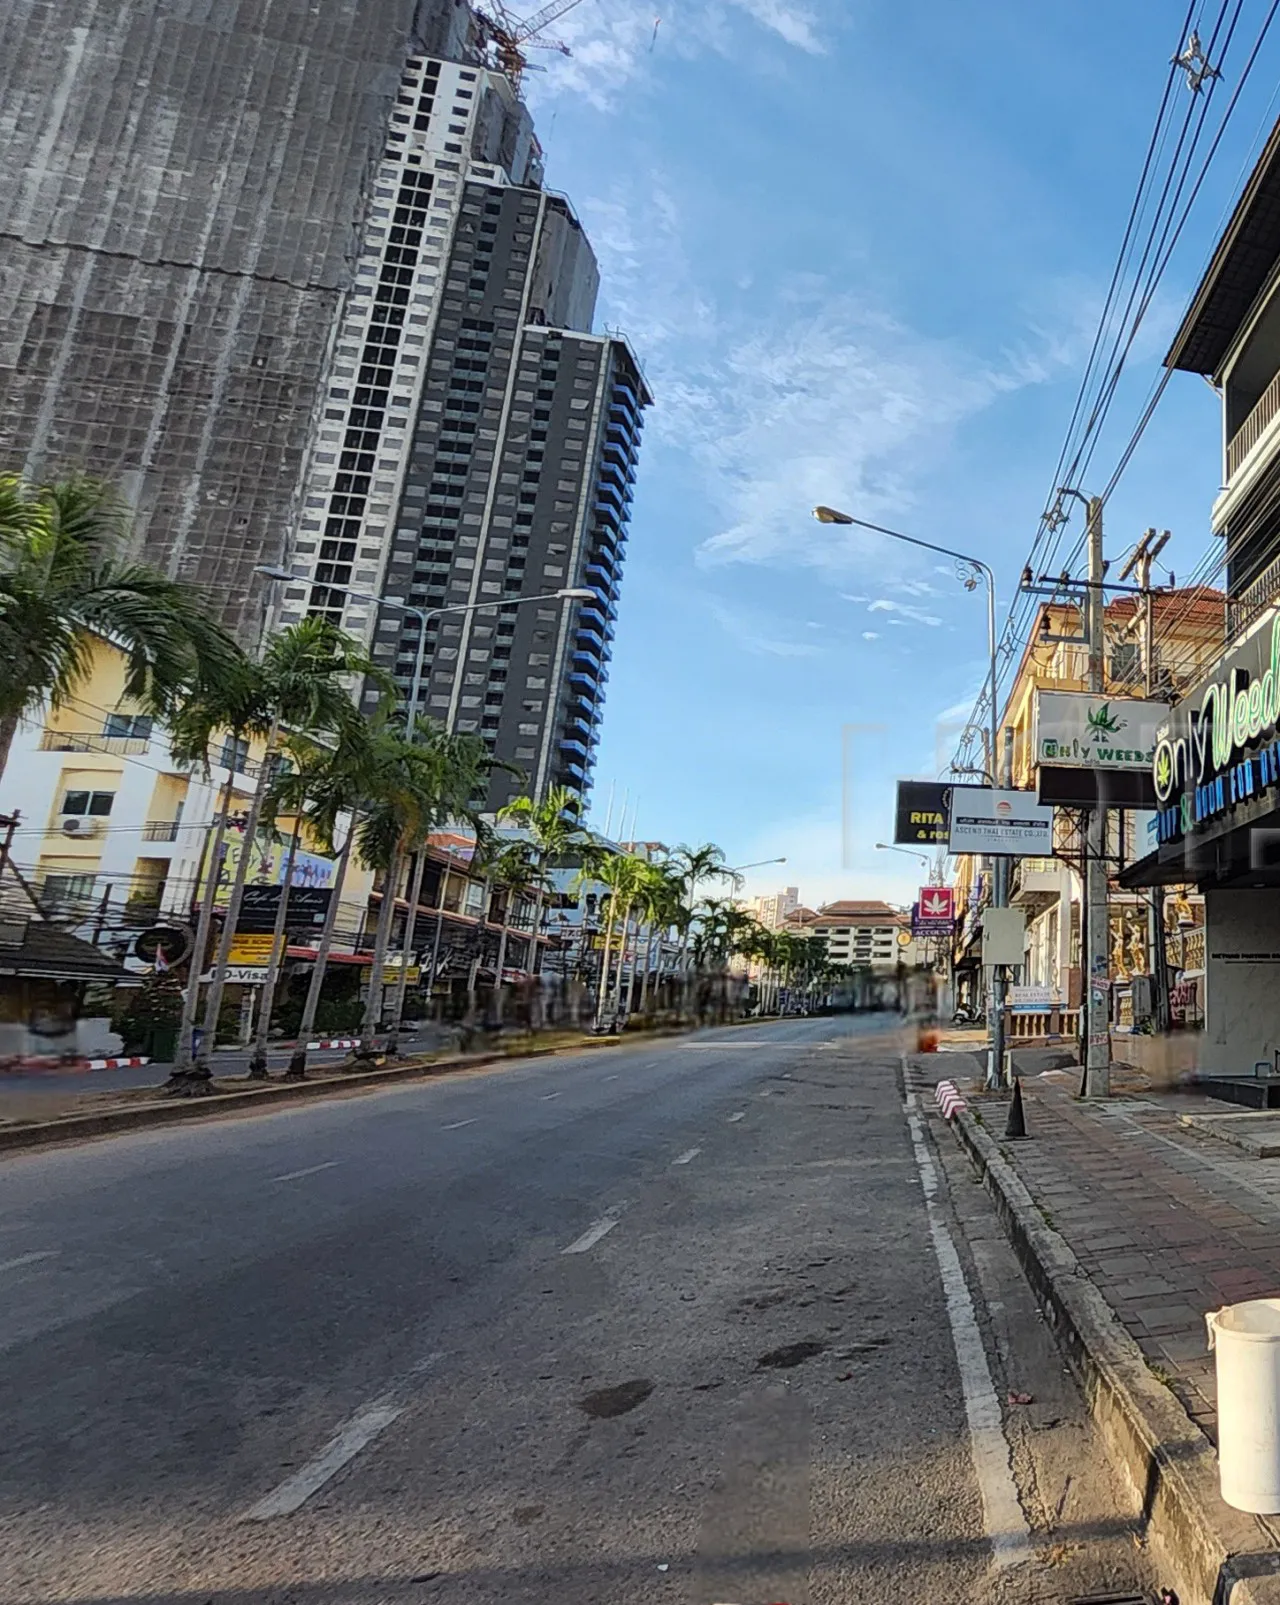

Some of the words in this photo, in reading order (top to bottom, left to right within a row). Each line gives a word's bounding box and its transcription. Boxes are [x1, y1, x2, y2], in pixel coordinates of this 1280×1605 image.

[1097, 747, 1155, 763] WEEDS
[1153, 709, 1208, 802] Only
[1229, 758, 1254, 804] FOR
[910, 812, 944, 825] RITA
[916, 830, 927, 839] &
[955, 826, 981, 835] ASCEND
[983, 827, 999, 835] THAI
[1001, 828, 1022, 837] ESTATE
